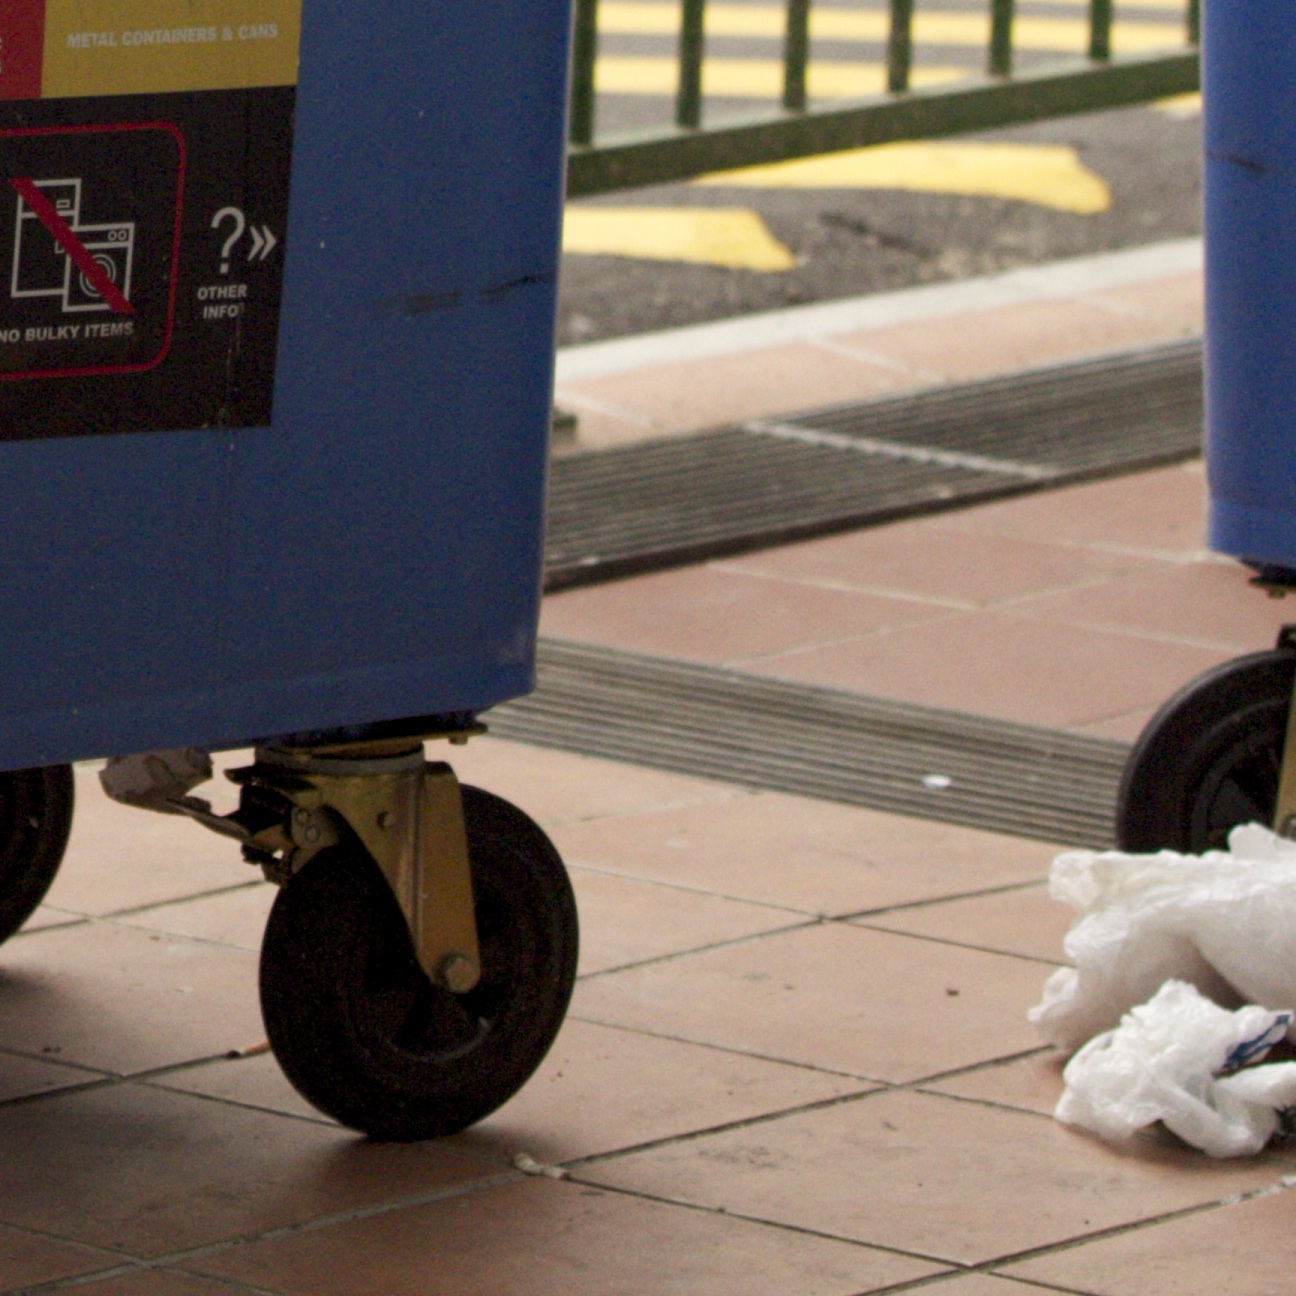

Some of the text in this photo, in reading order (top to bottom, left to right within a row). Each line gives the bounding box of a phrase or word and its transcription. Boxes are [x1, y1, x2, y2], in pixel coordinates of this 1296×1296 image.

[68, 23, 278, 48] METAL CONTAINERS & CANS
[197, 285, 247, 301] OTHER
[203, 304, 239, 320] INFO
[24, 324, 81, 342] BULKY
[84, 322, 134, 340] ITEMS
